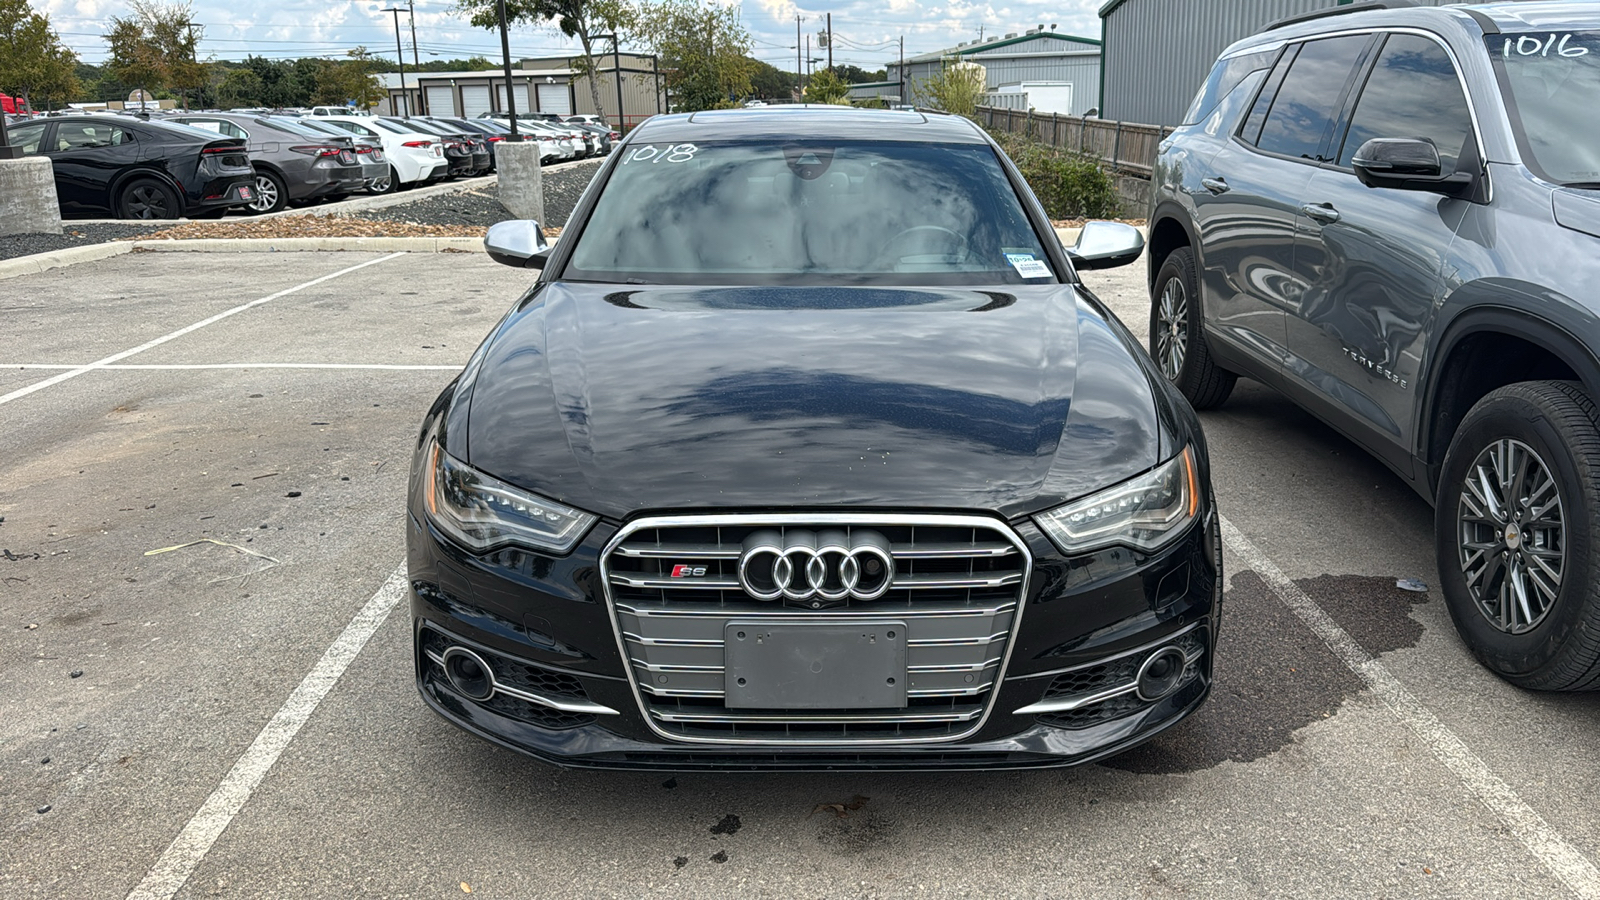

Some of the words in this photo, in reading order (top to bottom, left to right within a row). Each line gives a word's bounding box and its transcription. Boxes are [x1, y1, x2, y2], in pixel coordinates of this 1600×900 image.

[1503, 33, 1589, 58] 1016
[623, 143, 699, 165] 1018
[1342, 347, 1408, 389] TRAVERSE
[678, 567, 707, 577] S6
